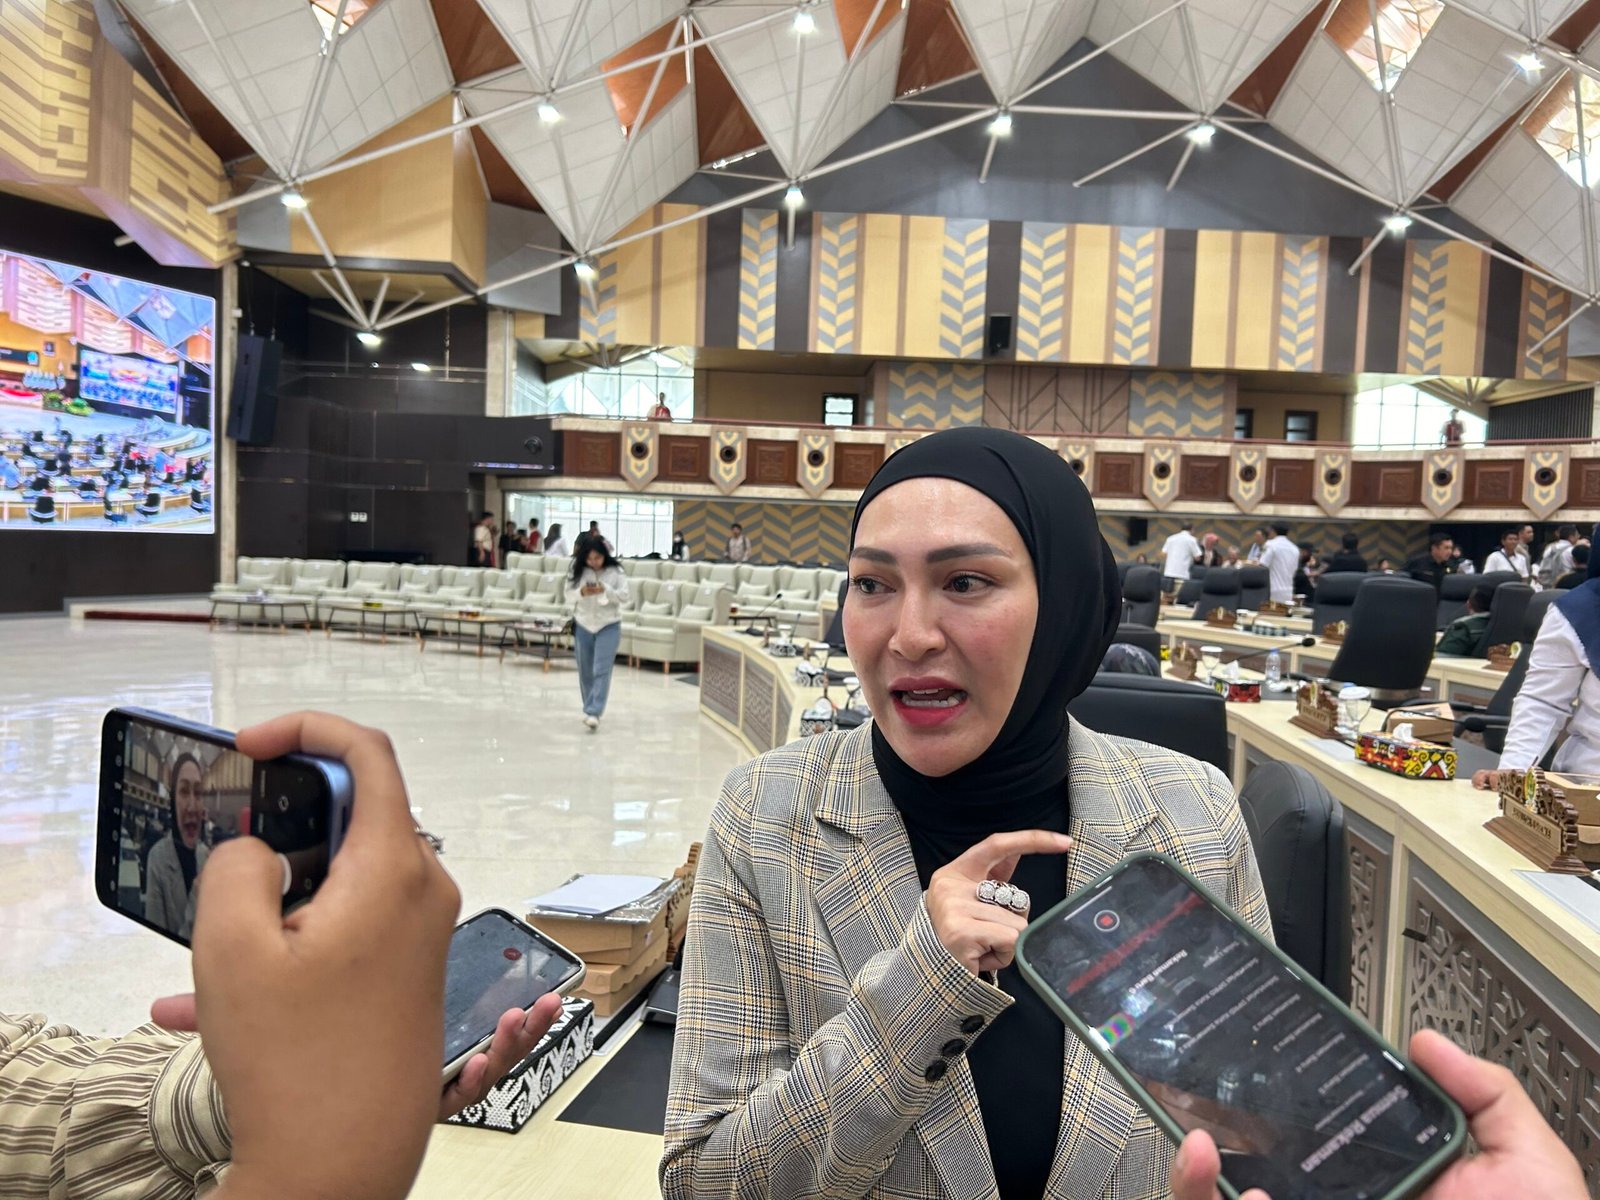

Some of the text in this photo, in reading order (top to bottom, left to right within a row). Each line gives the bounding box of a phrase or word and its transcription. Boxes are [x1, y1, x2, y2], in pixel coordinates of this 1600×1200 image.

[1151, 947, 1189, 978] Rekaman
[1126, 984, 1138, 996] 6
[1133, 972, 1155, 991] Baru
[1358, 1082, 1410, 1126] Semua
[1298, 1116, 1367, 1174] Rekaman
